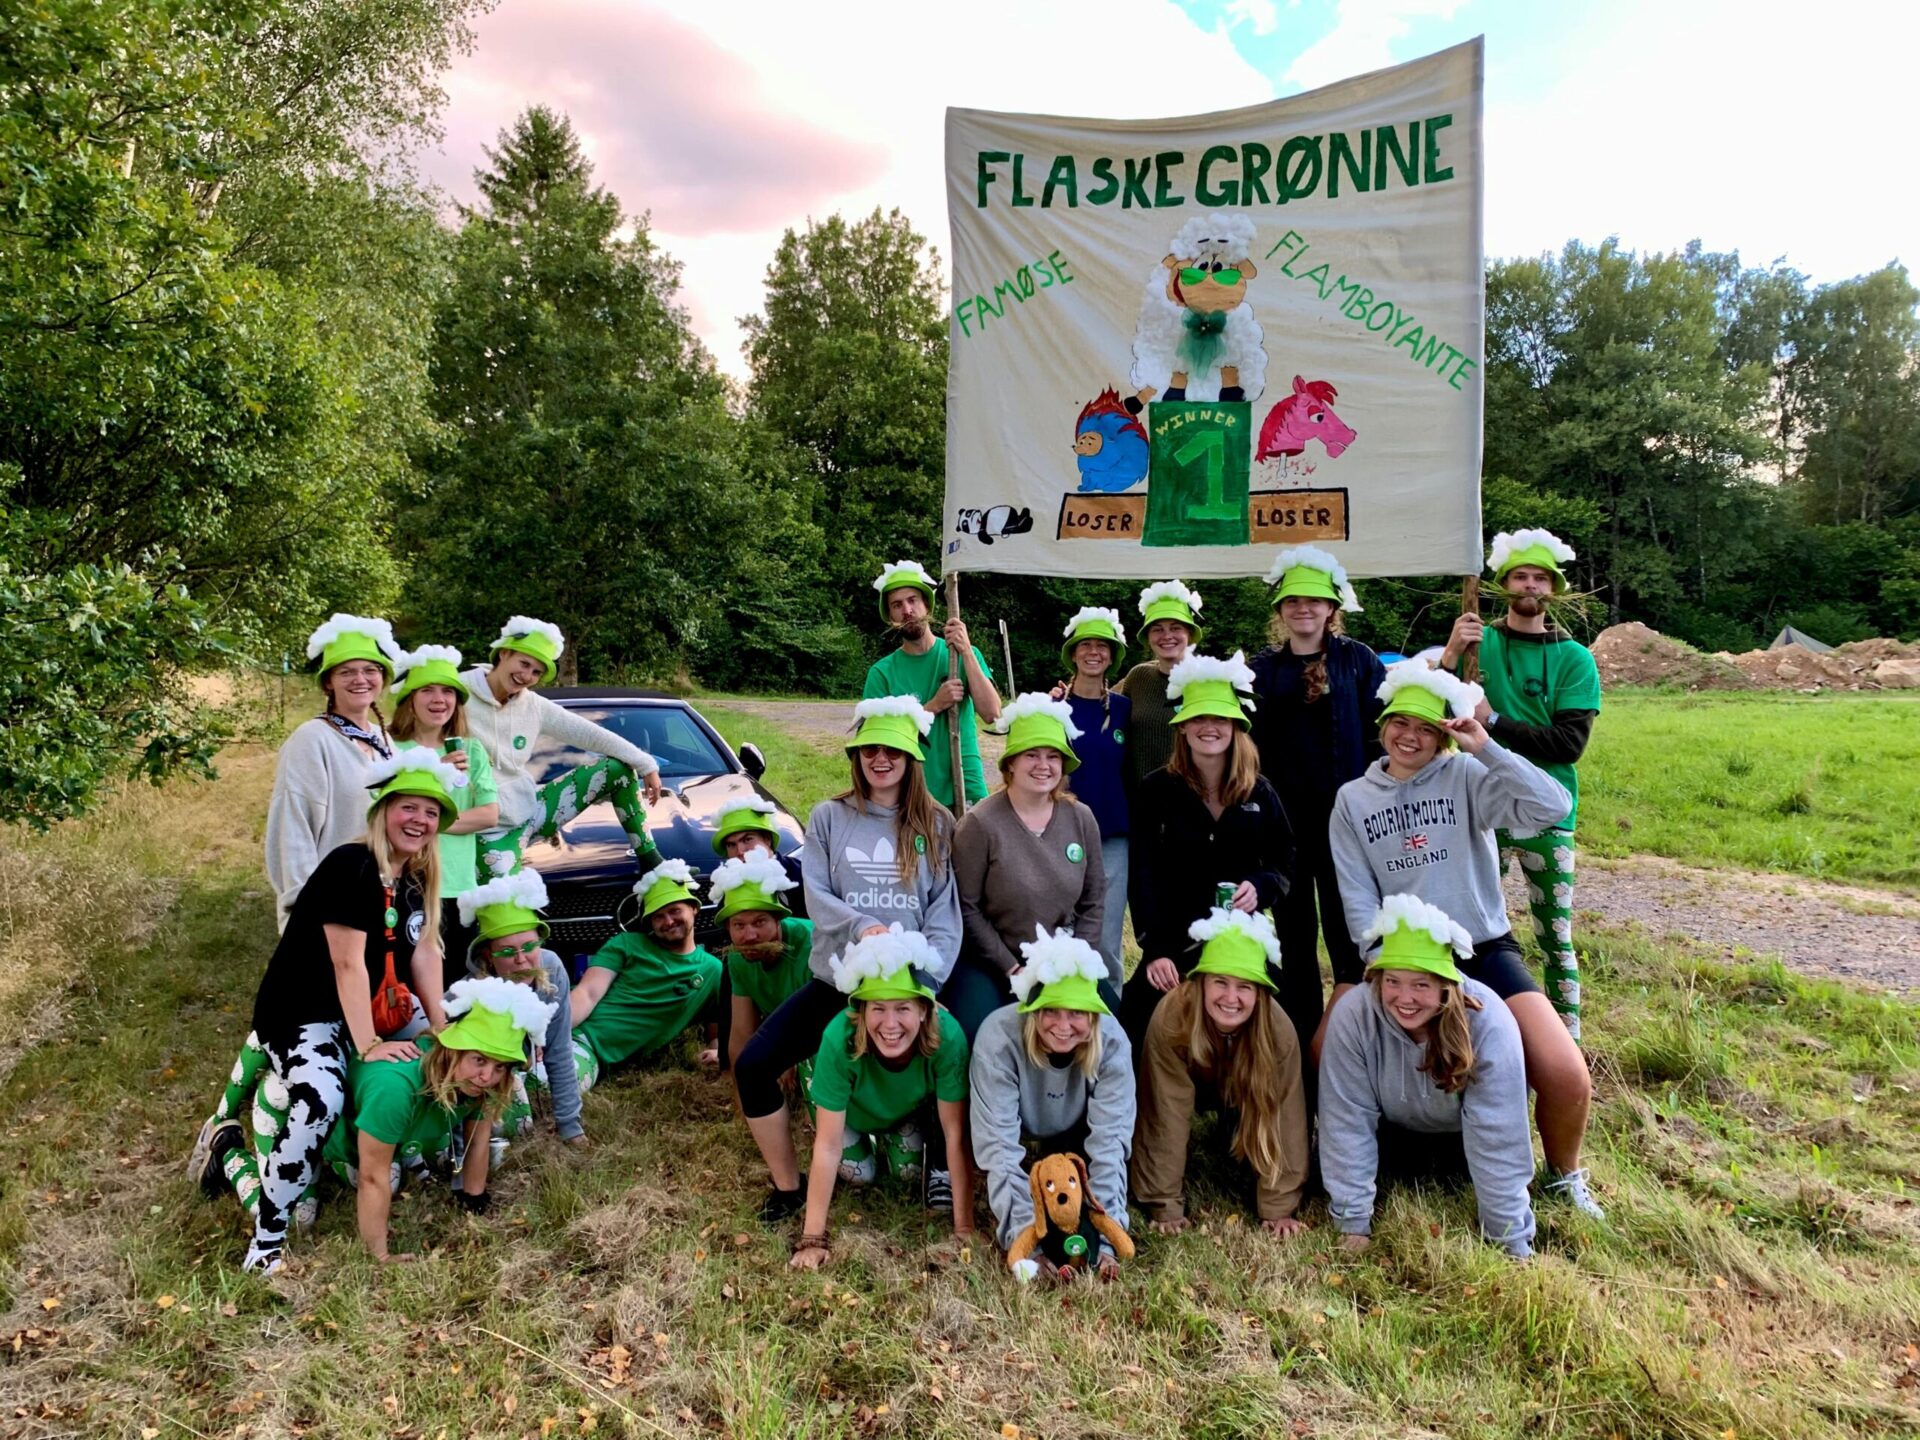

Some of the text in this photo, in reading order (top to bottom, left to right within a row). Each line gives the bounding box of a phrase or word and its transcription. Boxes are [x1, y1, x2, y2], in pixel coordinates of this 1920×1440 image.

[956, 250, 1074, 337] FAMØSE
[1264, 230, 1477, 391] FLAMBOYANTE
[1155, 409, 1236, 436] WINNER
[1173, 430, 1241, 520] 1
[1065, 510, 1133, 532] LOSER
[1257, 508, 1331, 528] LOSER
[1386, 848, 1448, 872] ENGLAND
[845, 887, 920, 910] adidas
